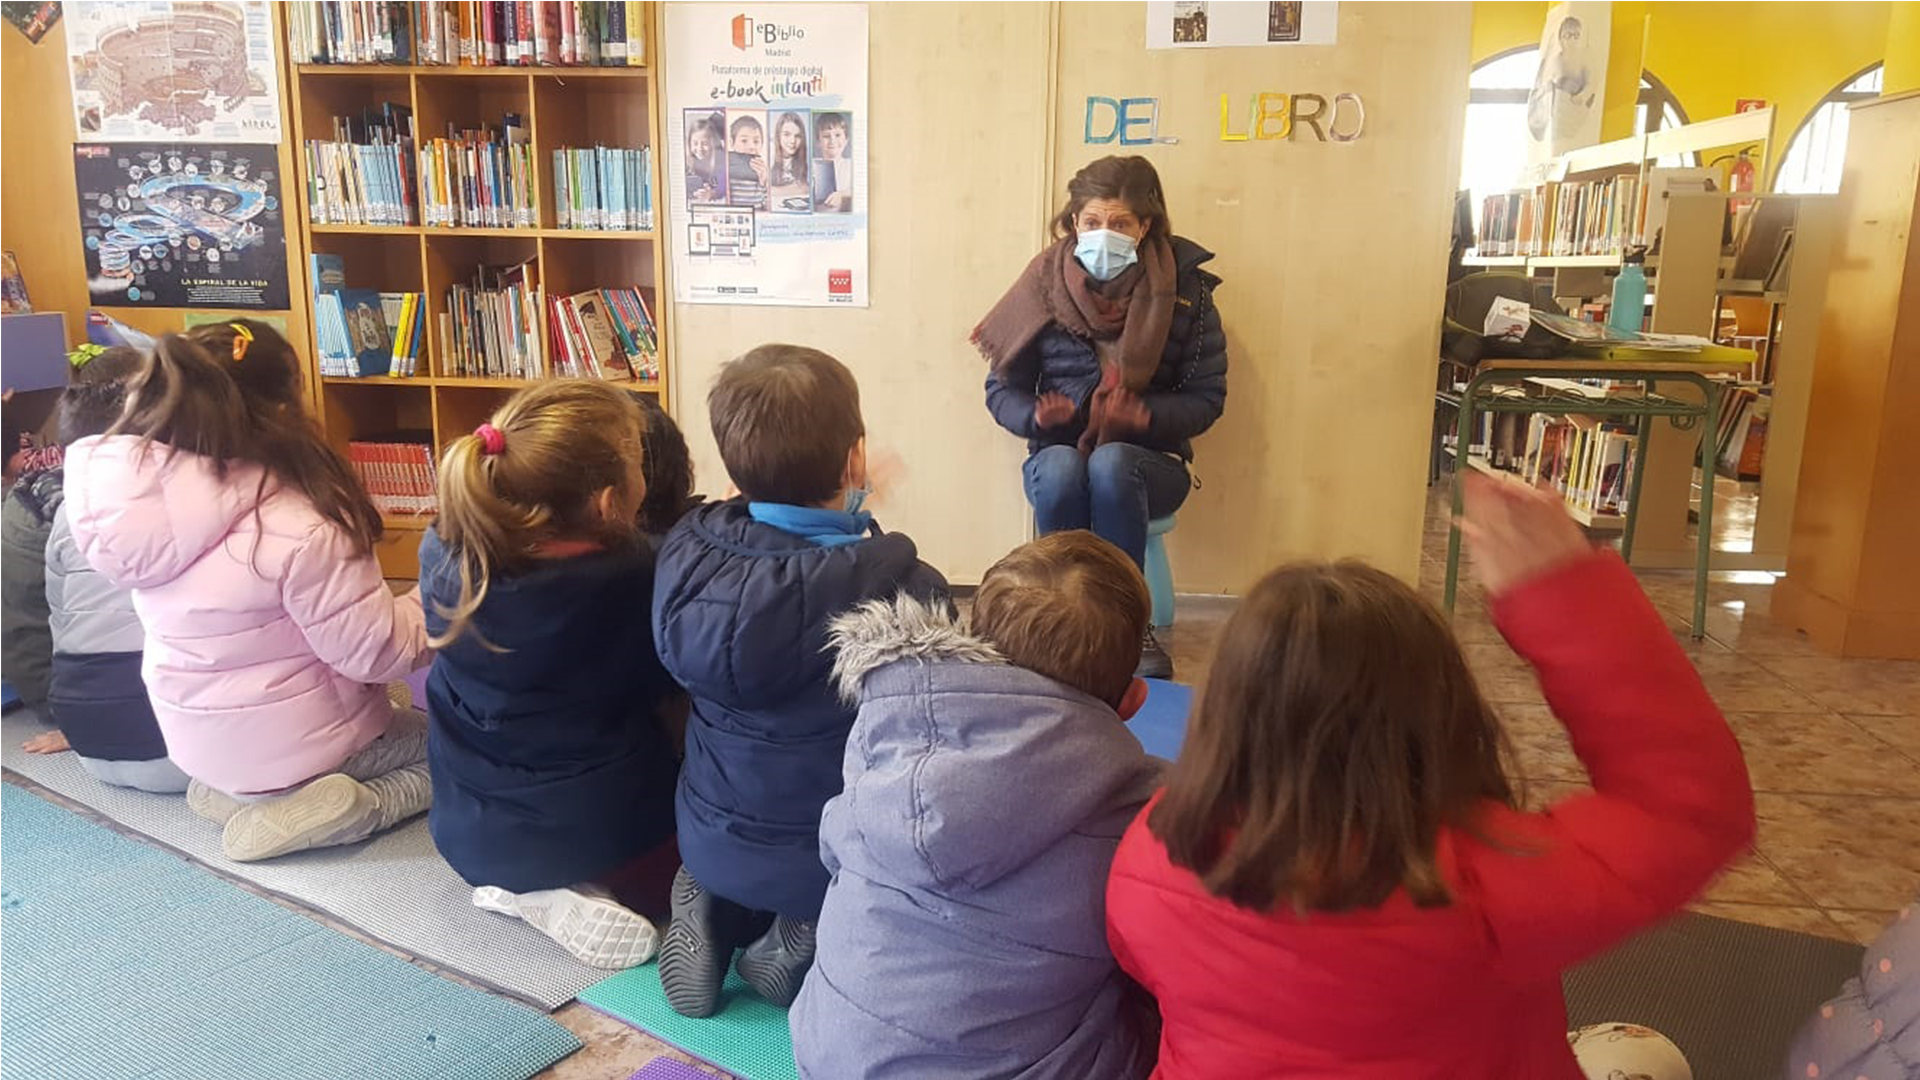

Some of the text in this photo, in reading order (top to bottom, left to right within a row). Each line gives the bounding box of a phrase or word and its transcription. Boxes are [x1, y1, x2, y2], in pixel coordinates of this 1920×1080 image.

[757, 23, 804, 43] eBiblio
[764, 48, 791, 57] Madrid
[710, 79, 771, 104] e-book
[1084, 92, 1365, 146] DEL LIBRO
